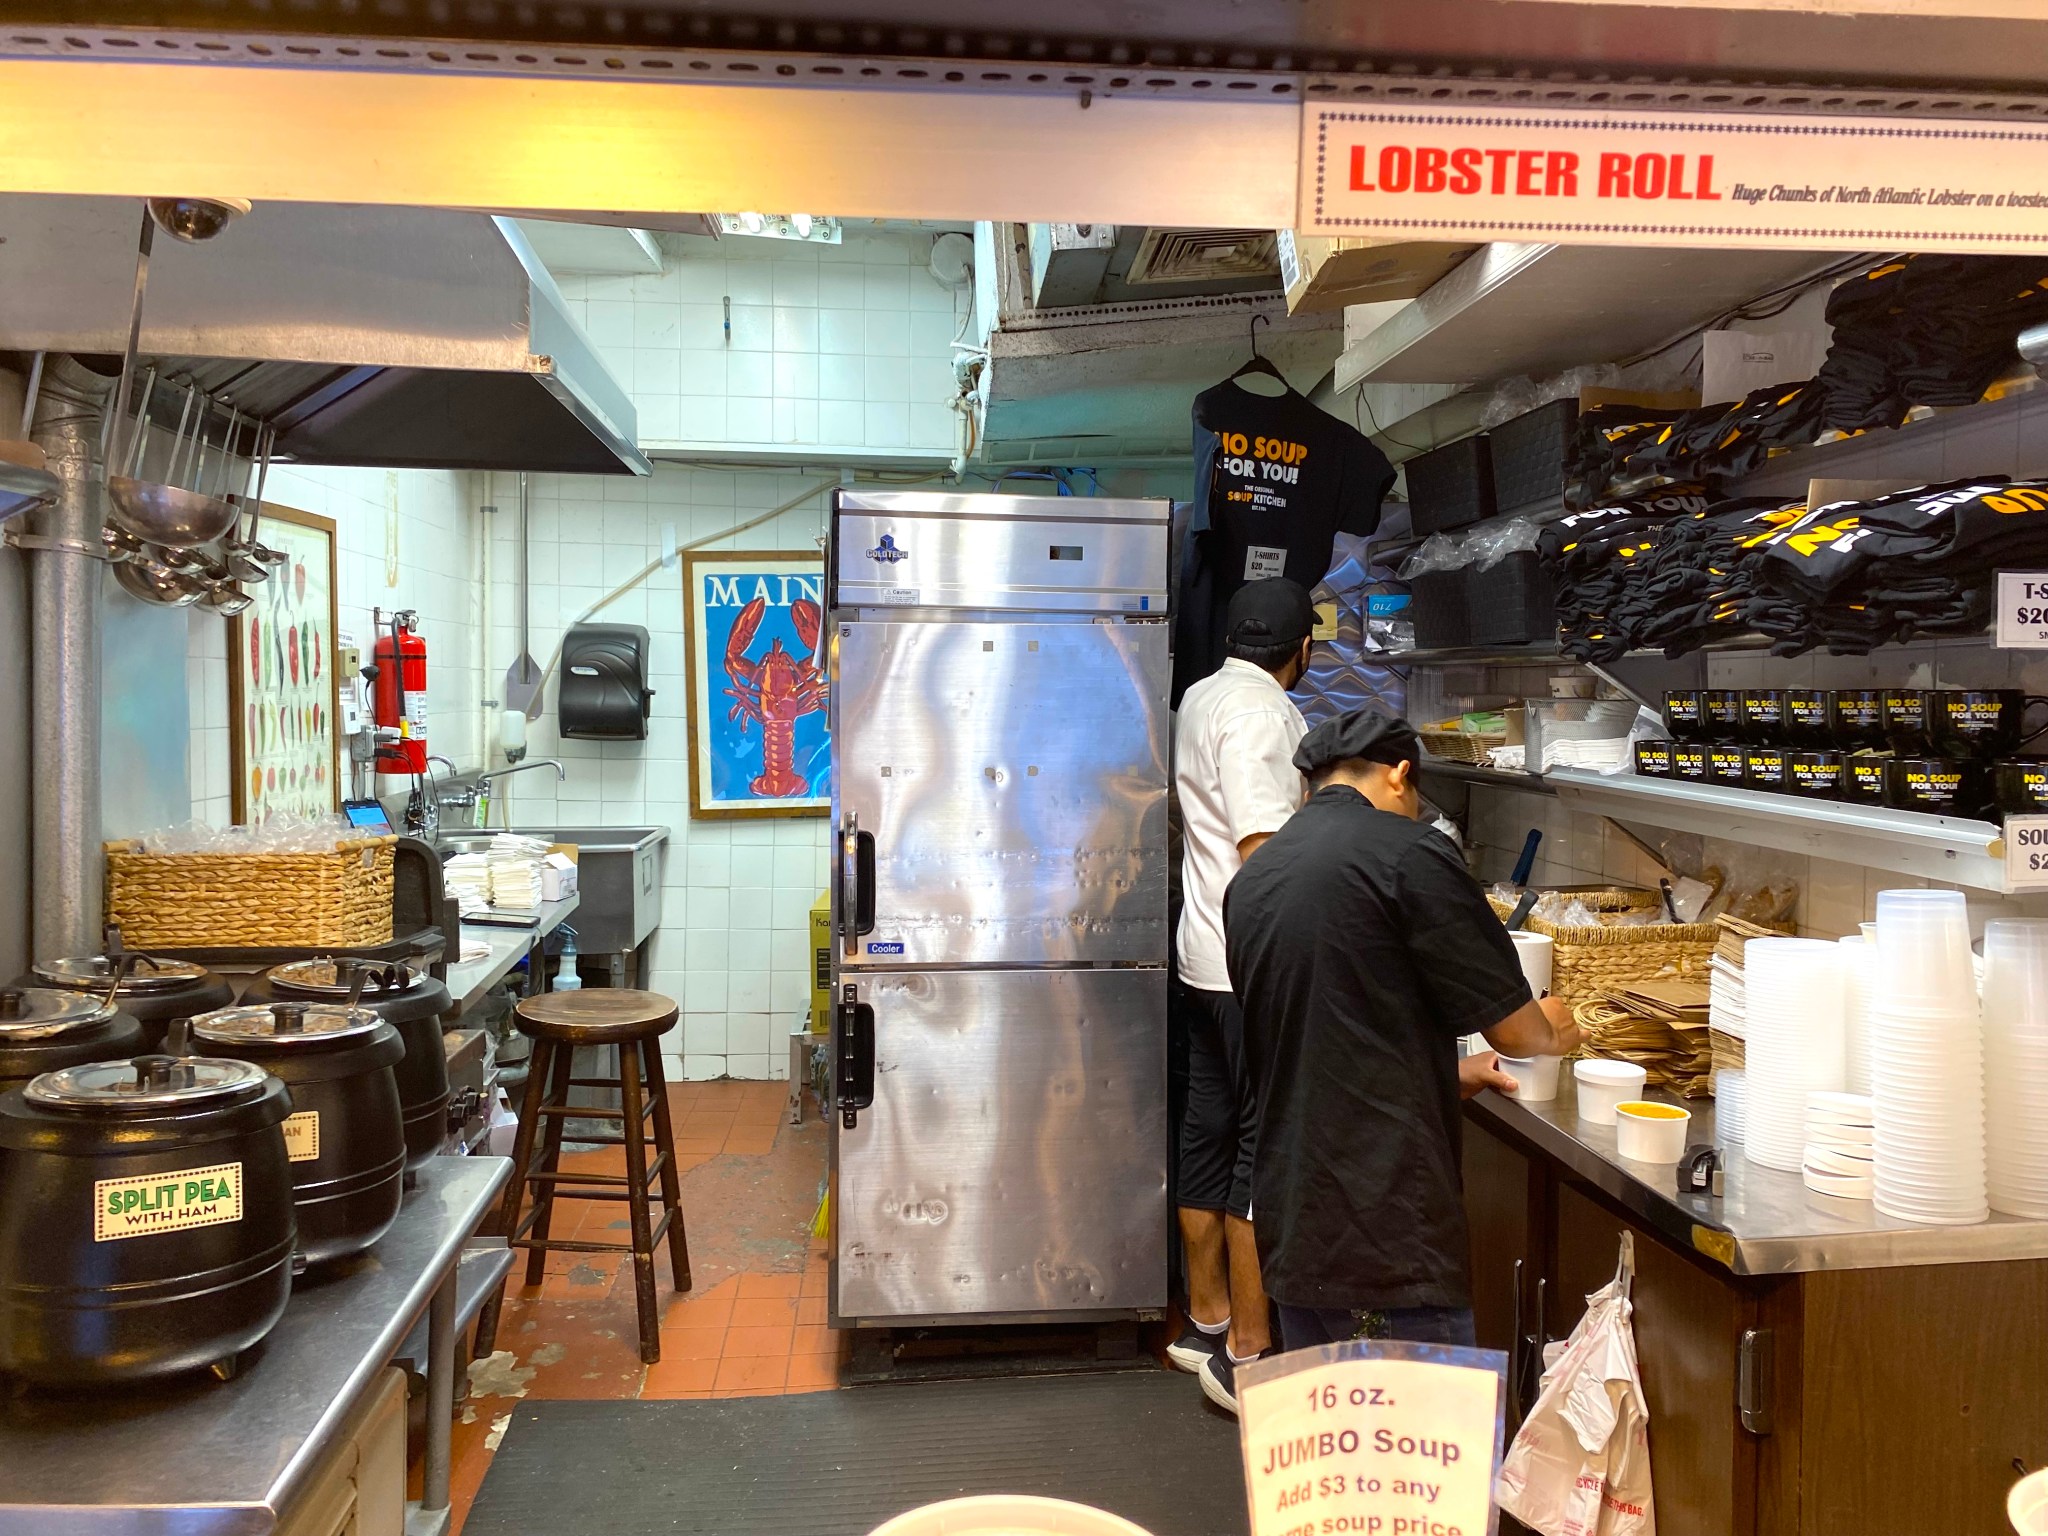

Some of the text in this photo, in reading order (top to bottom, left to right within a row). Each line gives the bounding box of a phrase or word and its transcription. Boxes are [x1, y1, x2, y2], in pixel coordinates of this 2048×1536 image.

[1349, 145, 1579, 198] LOBSTER
[1597, 151, 1722, 201] ROLL
[1732, 184, 1768, 205] Huge
[1768, 184, 1818, 202] Chunks
[1819, 186, 1836, 203] of
[1836, 185, 1871, 204] North
[1872, 187, 1926, 205] Atlantic
[1926, 188, 1977, 207] Lobster
[1976, 192, 1993, 207] on
[1995, 193, 2006, 207] a
[1254, 436, 1308, 465] SOUP
[1260, 461, 1299, 485] YOU!
[1227, 490, 1287, 508] SOUP KITCHEN
[1254, 550, 1280, 560] T-SHIRTS
[1251, 561, 1263, 571] $20
[1792, 701, 1806, 709] NO
[1839, 701, 1855, 709] NO
[1887, 699, 1902, 707] NO
[1947, 703, 2003, 712] NO SOUP
[1711, 754, 1724, 762] NO
[1749, 757, 1763, 765] NO
[1793, 764, 1809, 773] NO
[1855, 767, 1872, 775] NO
[1907, 774, 1962, 783] NO SOUP
[2024, 774, 2046, 784] NO
[1911, 782, 1932, 790] FOR
[871, 944, 901, 954] Cooler
[107, 1176, 232, 1216] SPLIT PEA
[125, 1203, 217, 1226] WITH HAM
[1308, 1384, 1396, 1412] 16 oz.
[1263, 1428, 1462, 1475] JUMBO Soup
[1276, 1475, 1441, 1513] Add $3 to any
[1321, 1516, 1382, 1536] soup
